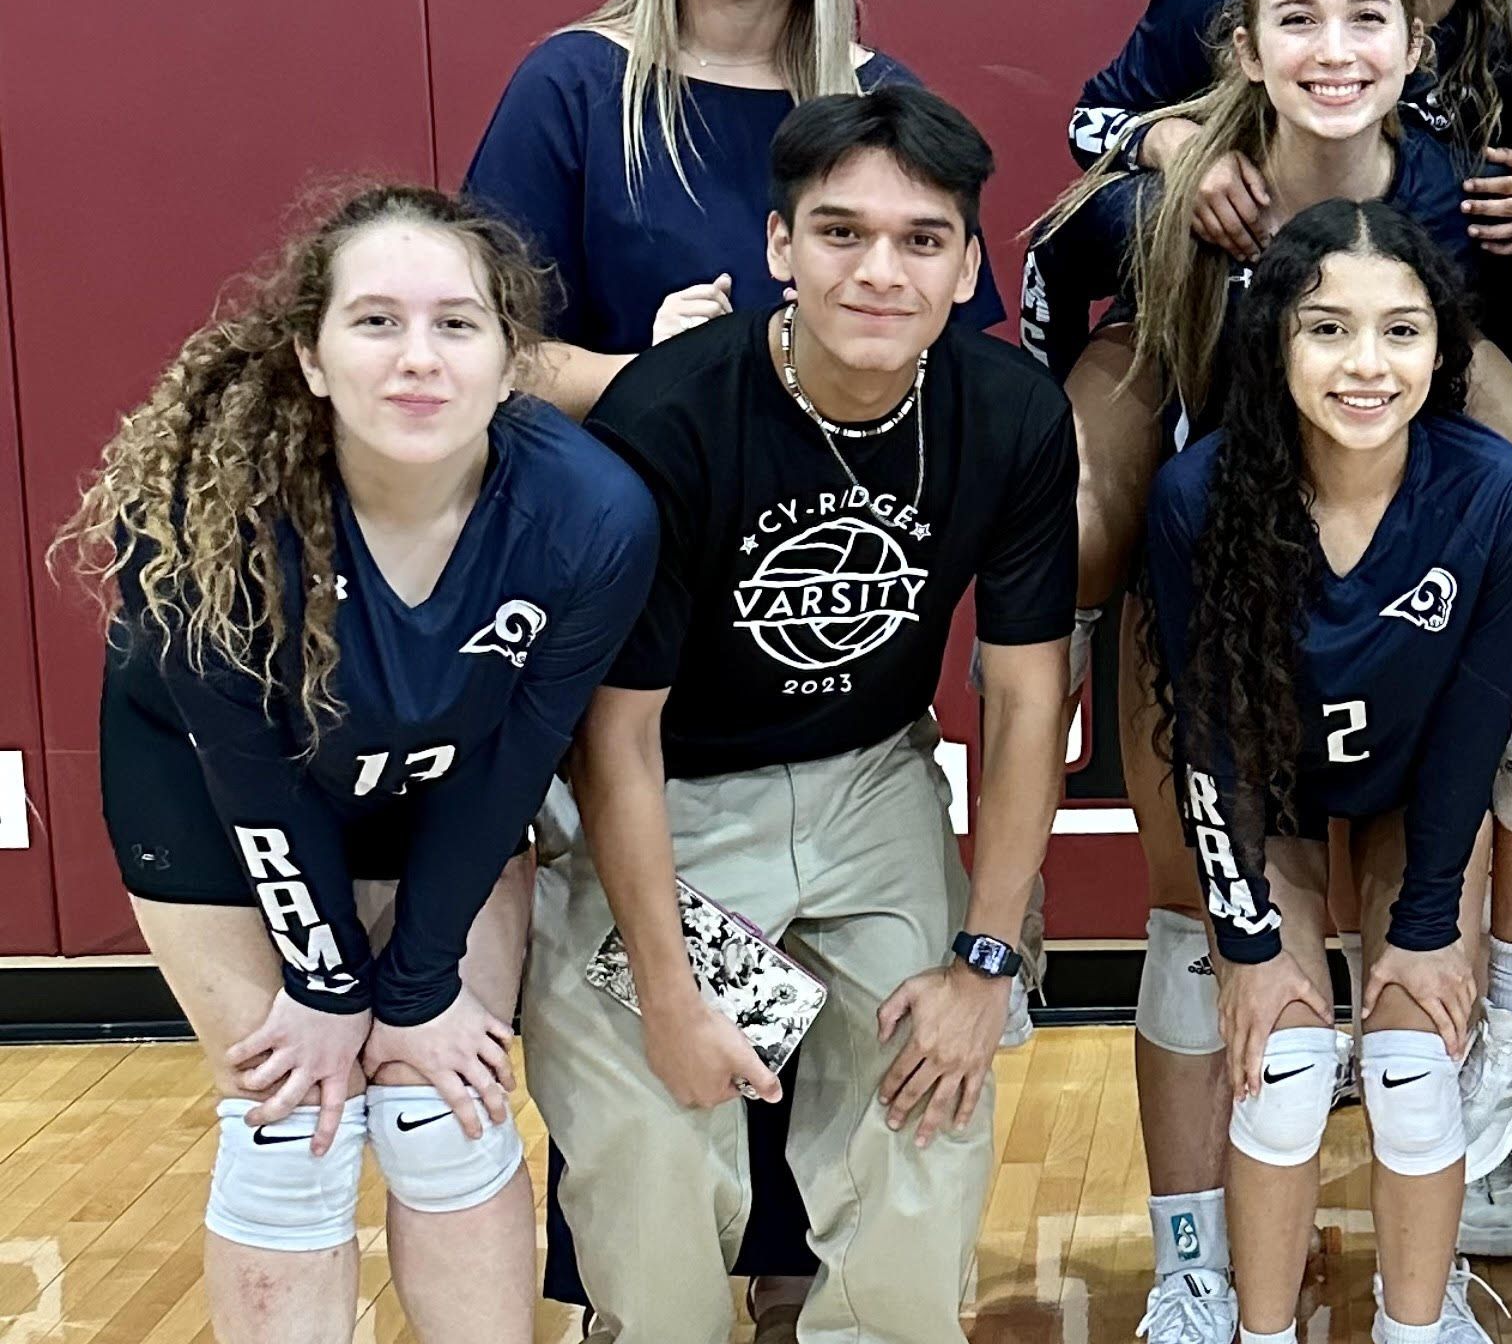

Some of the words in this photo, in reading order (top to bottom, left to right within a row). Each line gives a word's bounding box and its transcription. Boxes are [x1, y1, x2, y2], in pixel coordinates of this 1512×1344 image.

[758, 485, 919, 531] CY-RIDGE
[733, 576, 926, 619] VARSITY
[781, 673, 852, 695] 2023
[1322, 700, 1371, 763] 2
